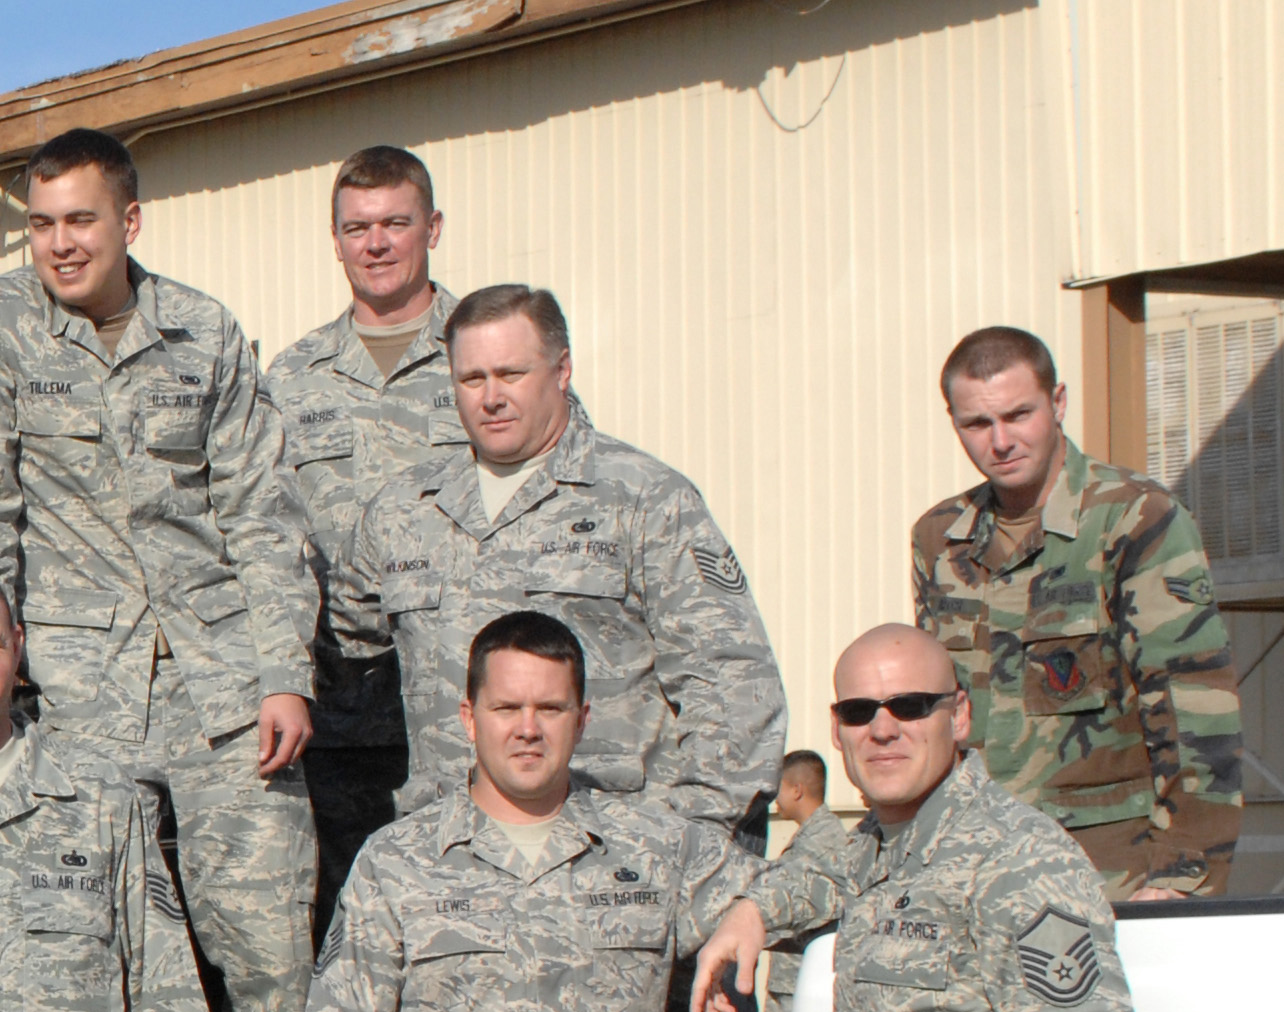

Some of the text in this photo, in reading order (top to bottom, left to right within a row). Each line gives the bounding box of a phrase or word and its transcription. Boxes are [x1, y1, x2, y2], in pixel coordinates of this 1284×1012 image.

[29, 381, 72, 395] TILLEMA
[152, 394, 169, 407] U.S.
[174, 395, 192, 407] AIR
[433, 396, 453, 409] U.S.
[299, 410, 336, 425] HARRIS
[540, 541, 619, 557] U.S. AIR FORCE
[32, 873, 105, 895] U.S. AIR FORCE
[435, 899, 471, 913] LEWIS
[589, 890, 660, 907] U.S. AIR FORCE
[899, 920, 938, 940] FORCE
